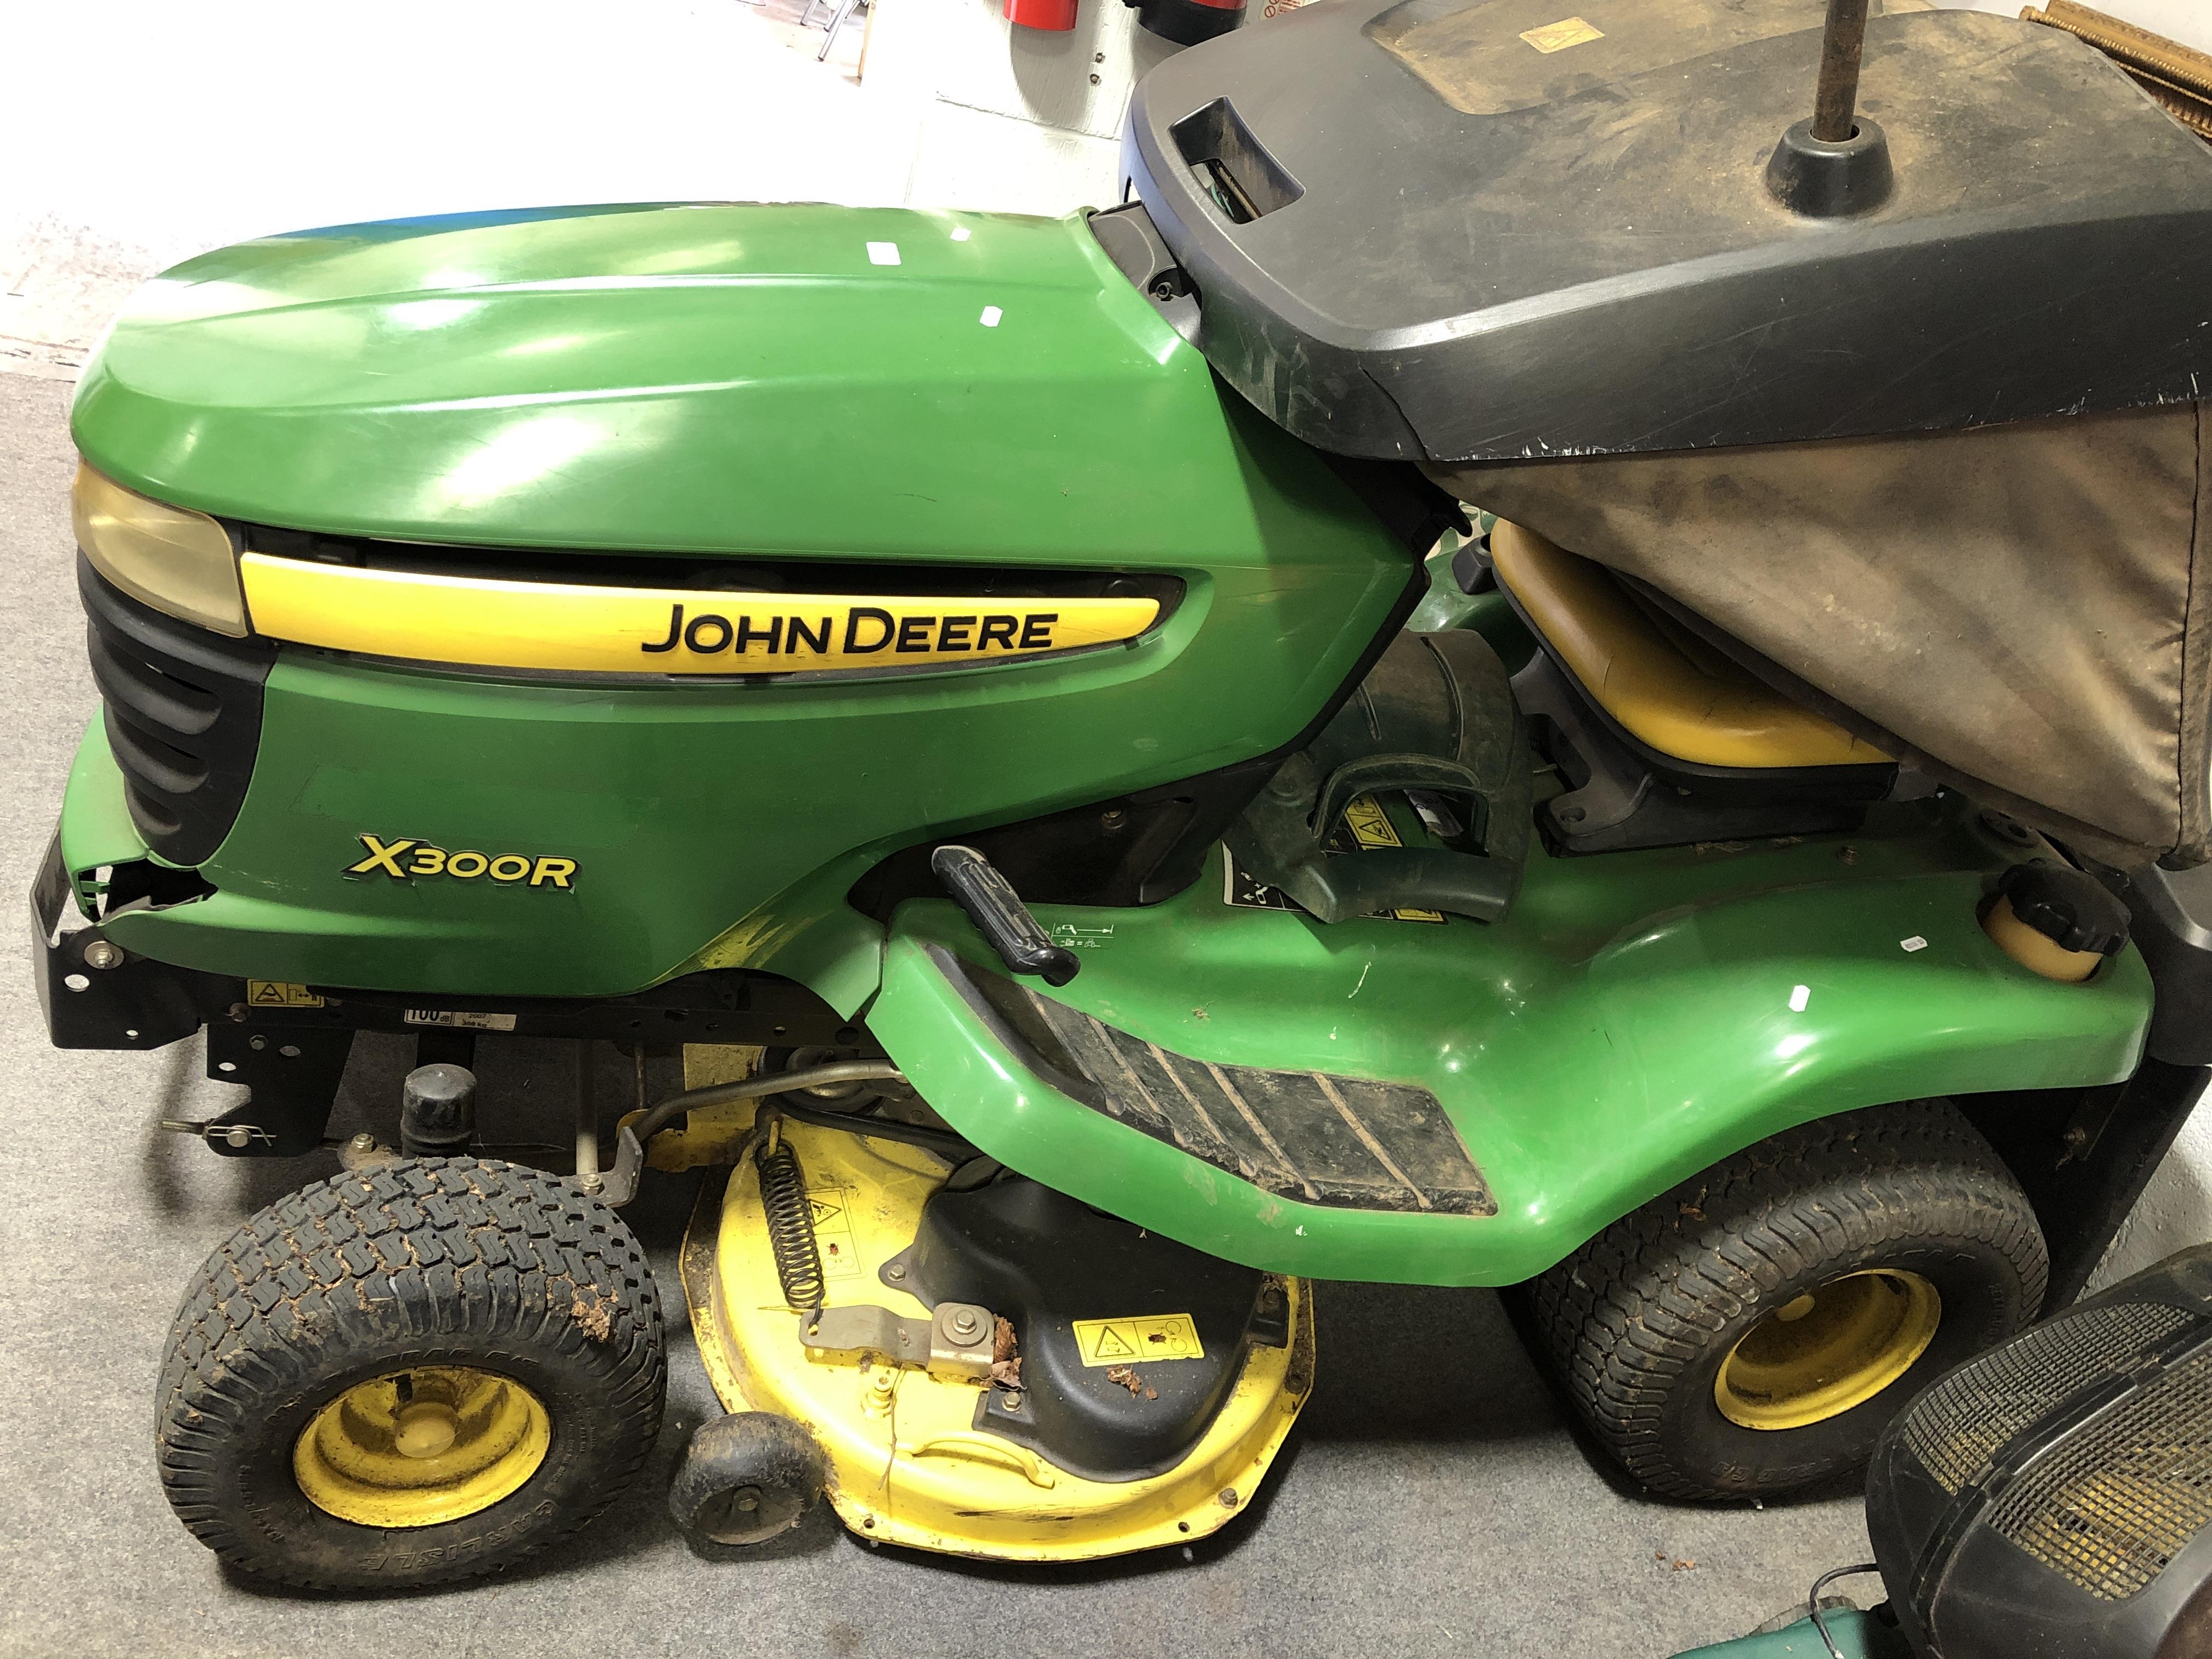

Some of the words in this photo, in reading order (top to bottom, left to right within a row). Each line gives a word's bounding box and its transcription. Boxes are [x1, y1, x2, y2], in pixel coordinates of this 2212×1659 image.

[641, 603, 833, 654] JOHN
[842, 607, 1059, 653] DEERE
[345, 834, 577, 888] X300R
[358, 1498, 556, 1570] CARLISLE
